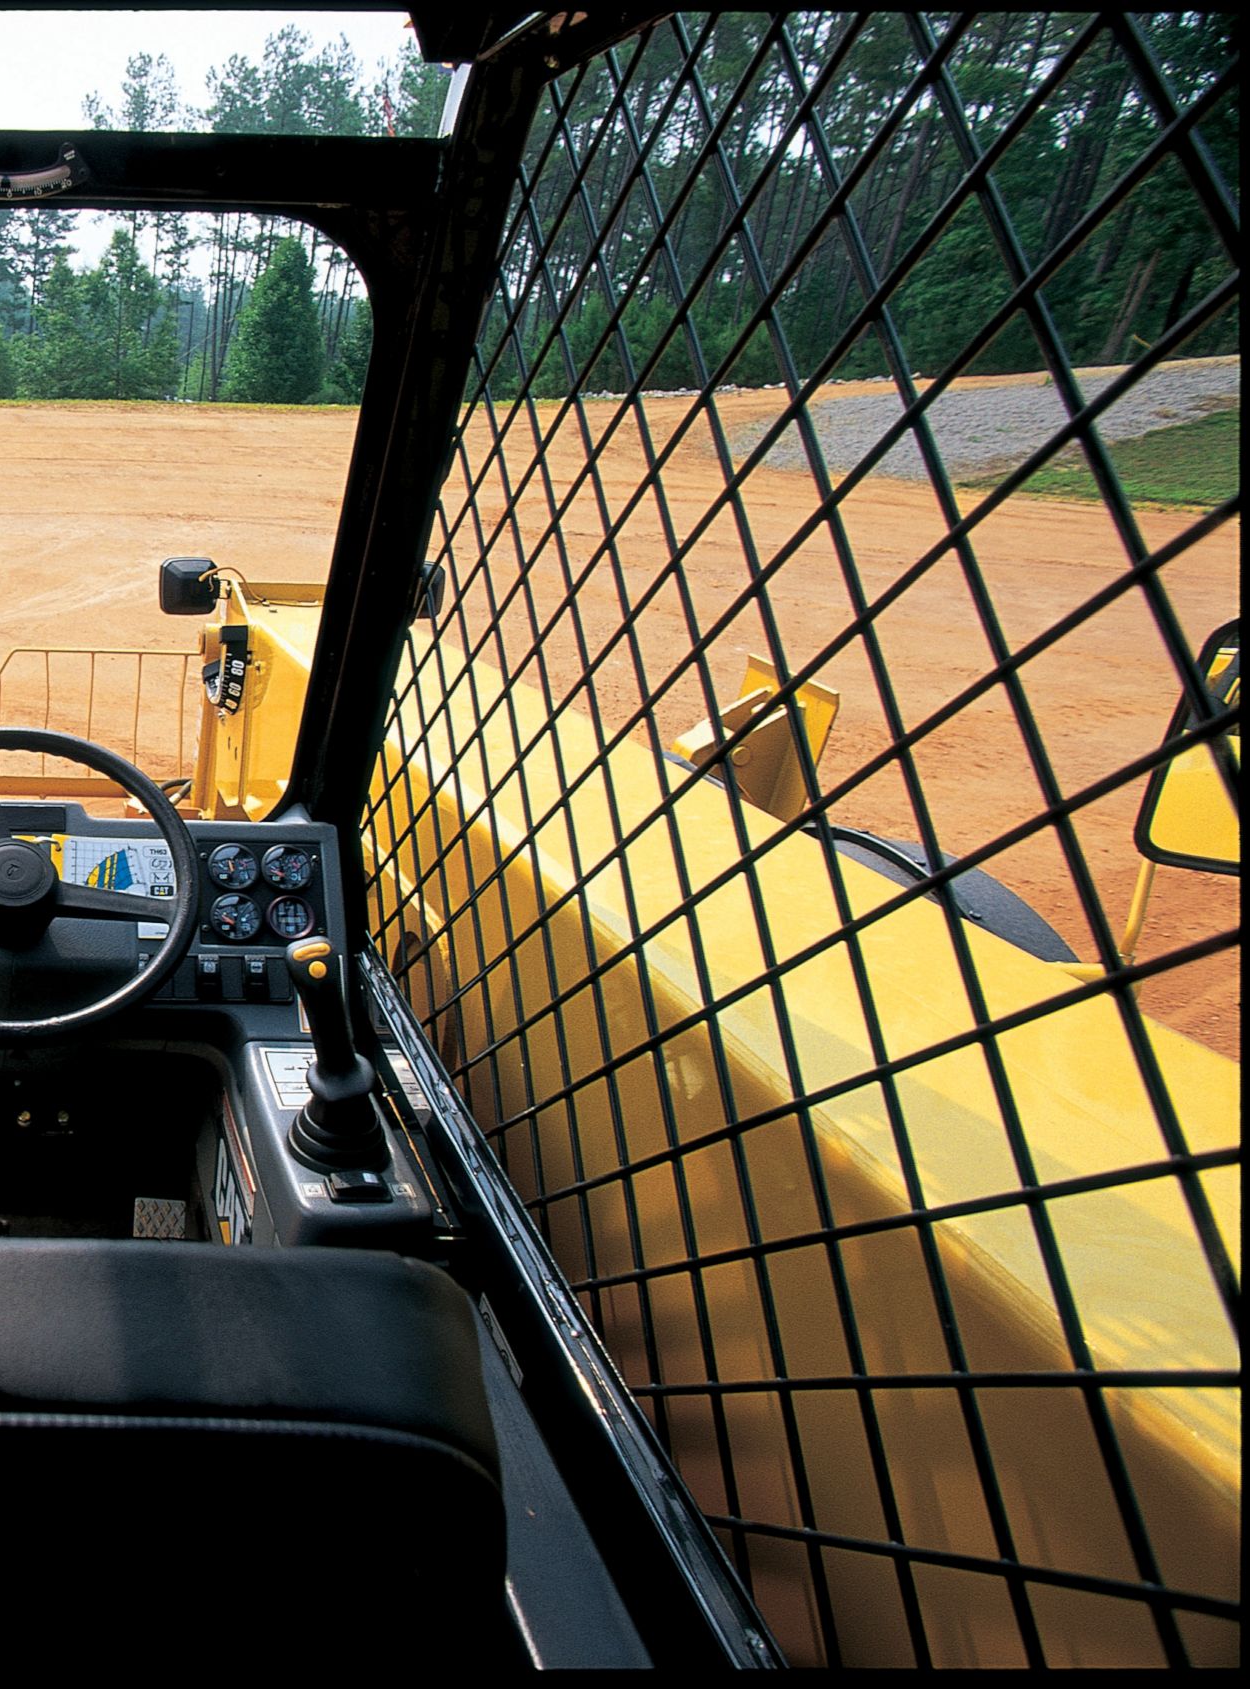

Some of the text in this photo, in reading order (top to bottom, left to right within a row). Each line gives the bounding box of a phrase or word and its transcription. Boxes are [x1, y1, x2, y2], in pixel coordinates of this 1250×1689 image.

[231, 660, 244, 677] 80
[228, 682, 241, 697] 60
[150, 848, 167, 856] TH63
[153, 886, 169, 896] CAT
